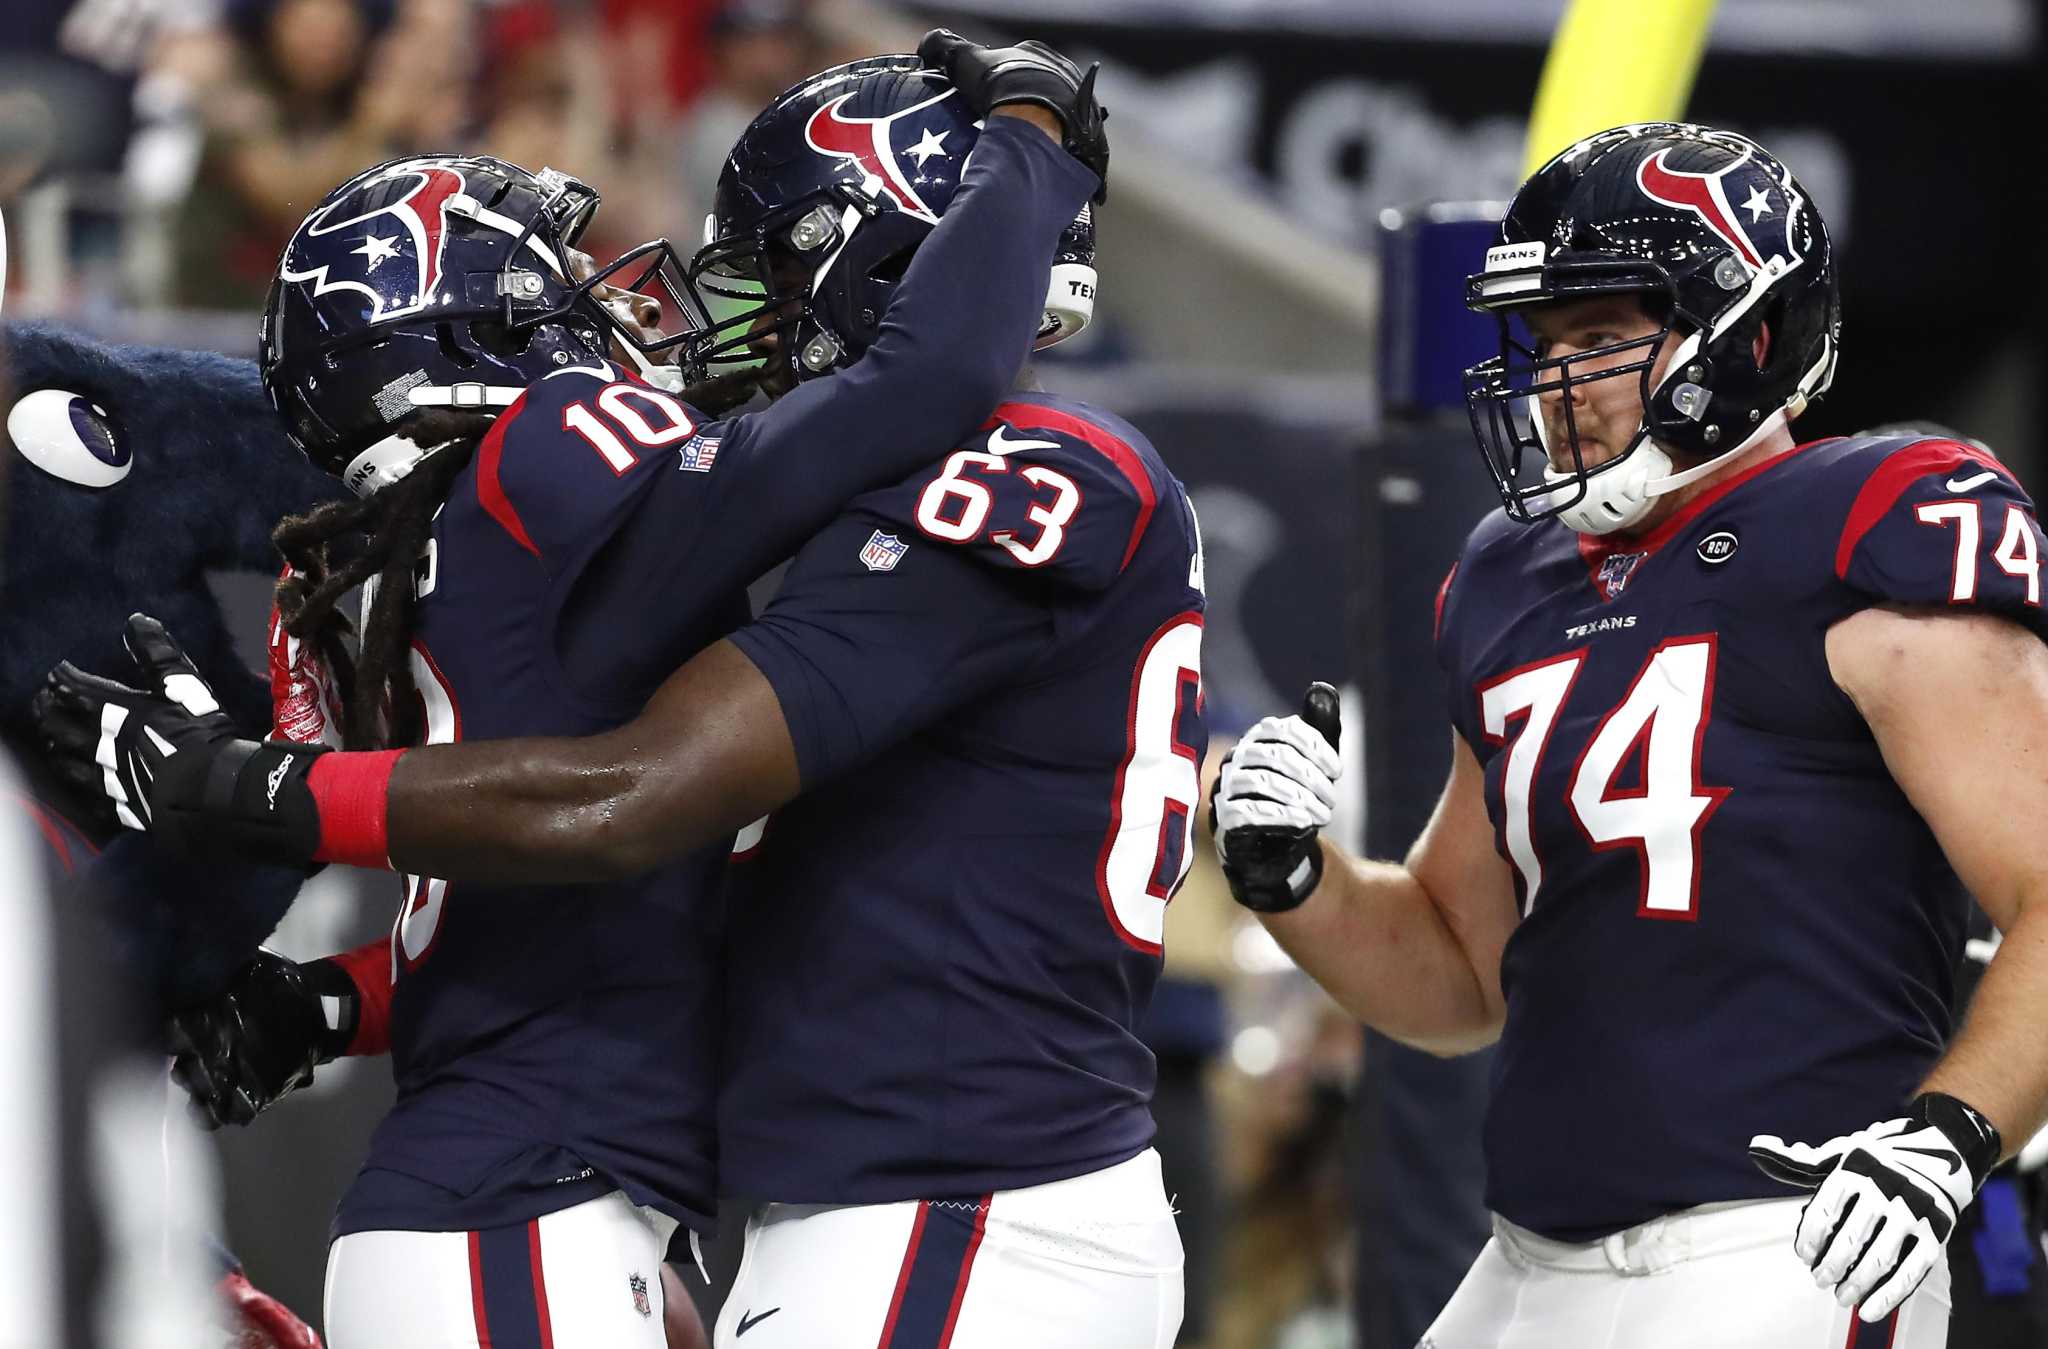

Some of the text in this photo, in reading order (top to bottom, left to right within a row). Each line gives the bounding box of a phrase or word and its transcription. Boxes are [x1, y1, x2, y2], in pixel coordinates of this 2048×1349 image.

[1488, 250, 1538, 263] TEXANS
[561, 382, 697, 478] 10
[698, 440, 721, 468] NFL
[913, 449, 1086, 568] 63
[864, 544, 893, 567] NFL
[1912, 498, 2045, 607] 74
[1565, 616, 1638, 640] TEXANS
[1473, 631, 1735, 922] 74
